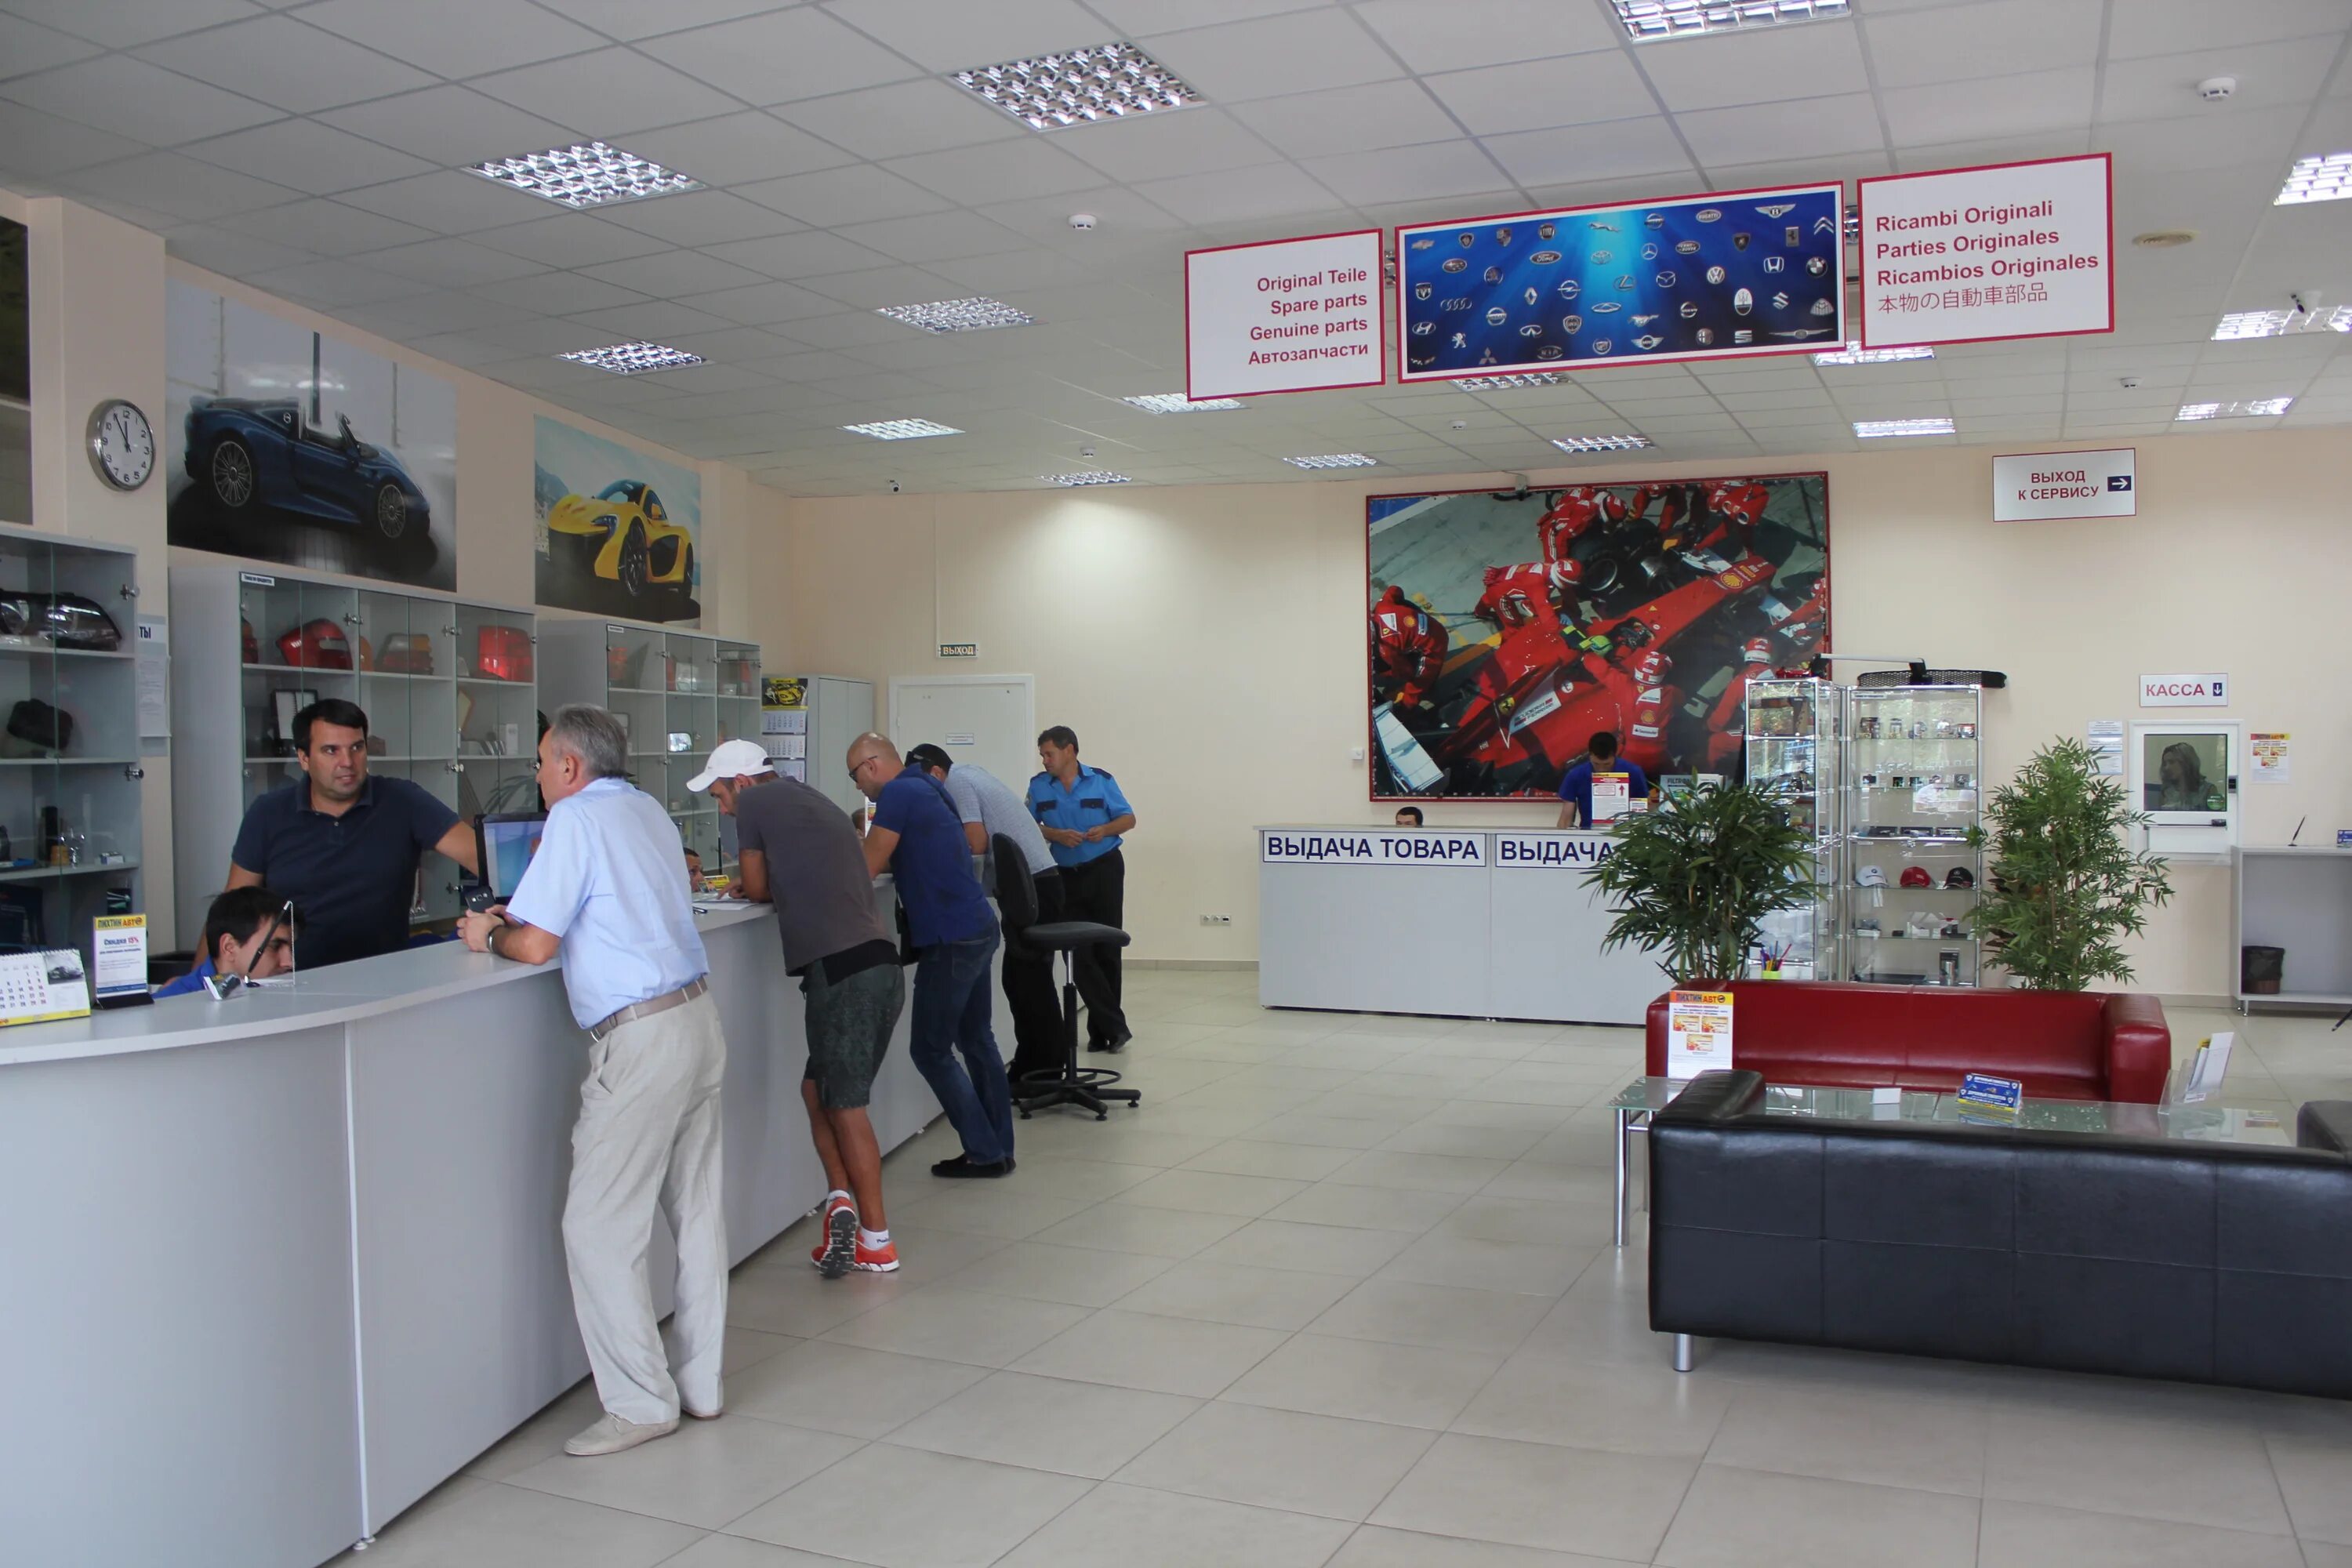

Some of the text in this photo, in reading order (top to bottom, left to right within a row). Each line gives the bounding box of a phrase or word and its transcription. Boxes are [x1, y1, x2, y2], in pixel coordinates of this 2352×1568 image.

[1876, 201, 2053, 233] Ricambi Originali
[1877, 229, 2060, 260] Parties Originales
[1257, 268, 1367, 292] Original Teile
[1878, 253, 2099, 286] Ricambios Originales
[1271, 293, 1367, 317] Spare parts
[1878, 281, 2048, 314] 本物の自動車部品
[1250, 318, 1368, 340] Genuine parts
[1248, 343, 1368, 365] Автозапчасти
[2031, 470, 2086, 484] ВЫХОД
[2018, 485, 2100, 501] К СЕРВИСУ
[943, 645, 974, 655] ВЫХОД
[2146, 683, 2205, 697] КАССА
[1268, 837, 1479, 860] ВЫДАЧА ТОВАРА
[1501, 840, 1613, 866] ВЫДАЧА
